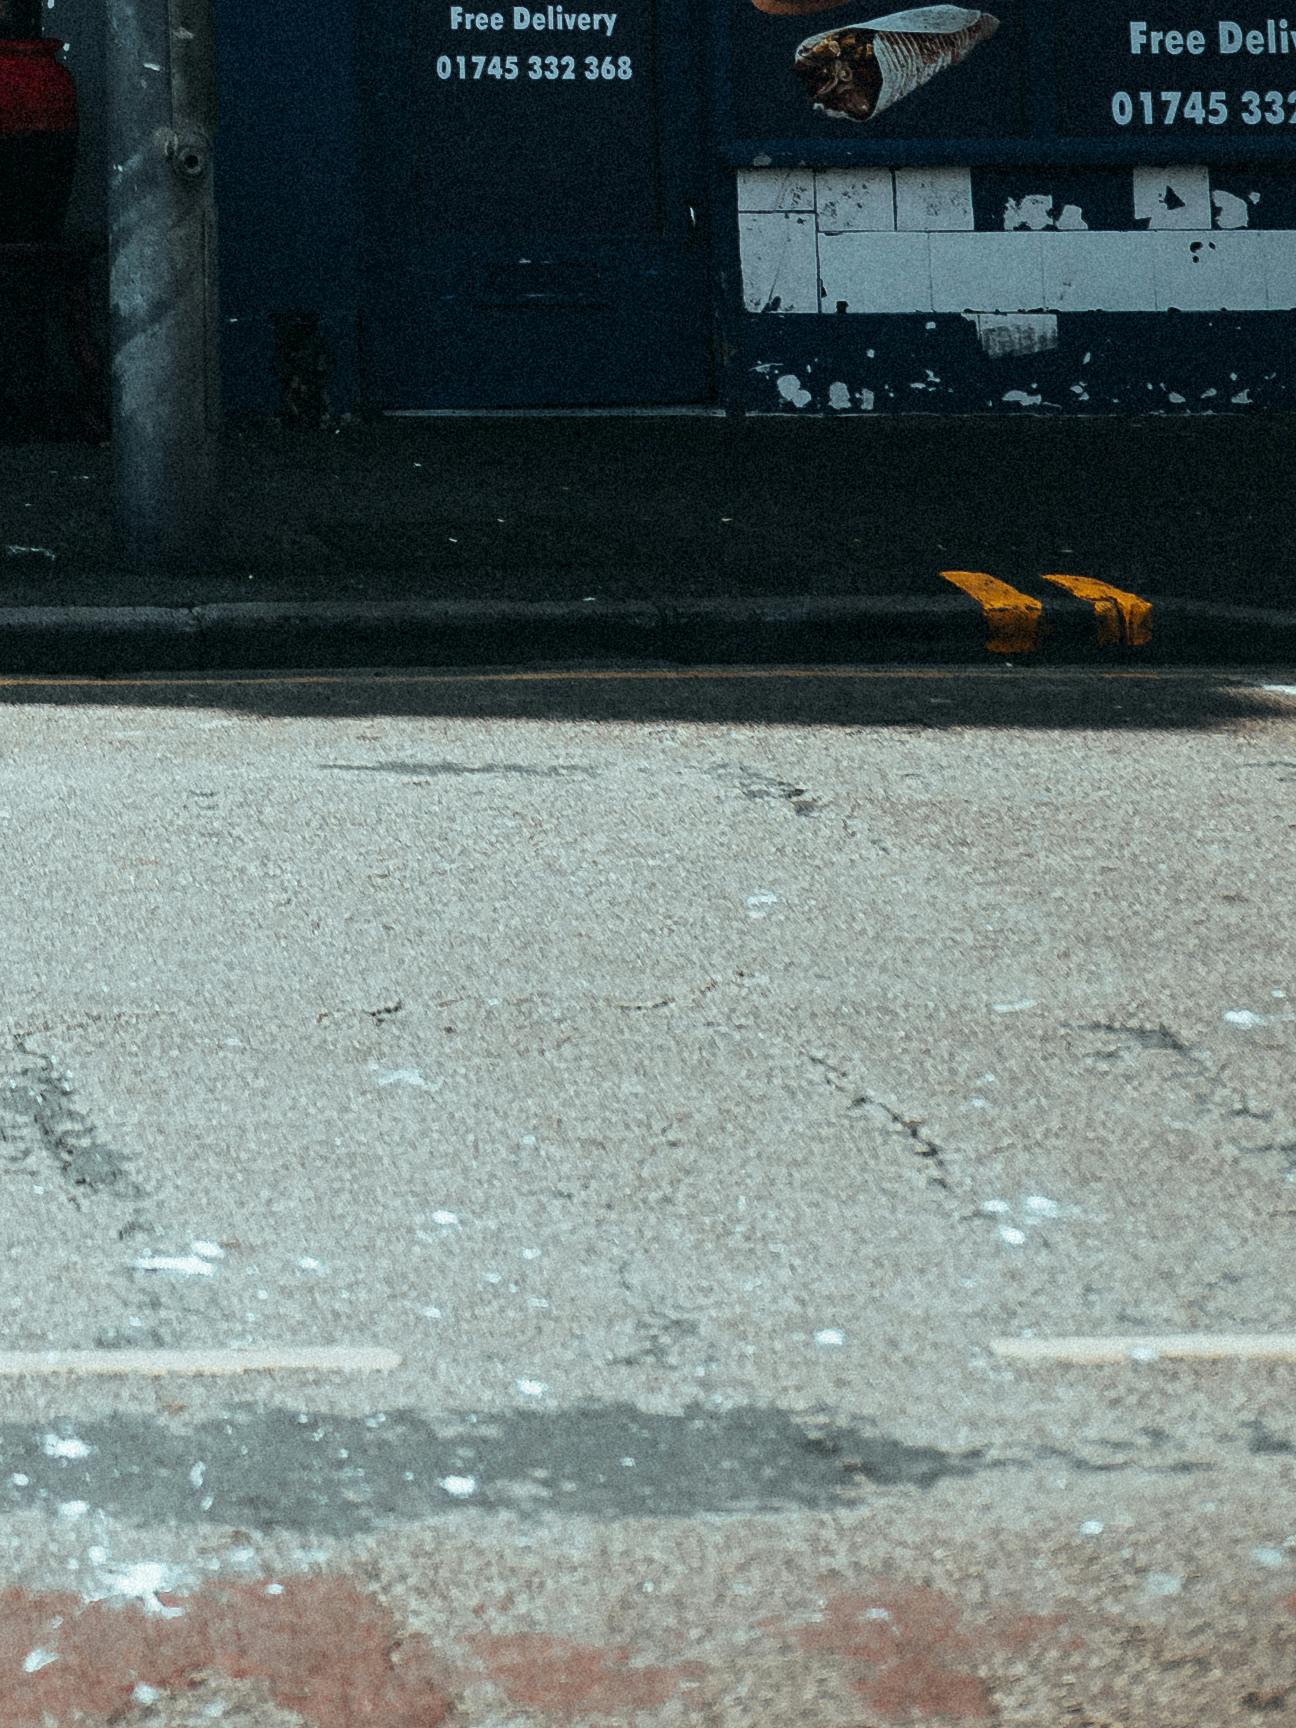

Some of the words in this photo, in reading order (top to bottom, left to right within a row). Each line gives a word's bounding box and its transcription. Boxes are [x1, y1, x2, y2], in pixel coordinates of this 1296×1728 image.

[451, 6, 505, 31] Free
[513, 4, 617, 37] Delivery
[1129, 20, 1206, 55] Free
[436, 55, 519, 80] 01745
[527, 55, 576, 80] 332
[584, 55, 633, 81] 368
[1111, 90, 1229, 125] 01745
